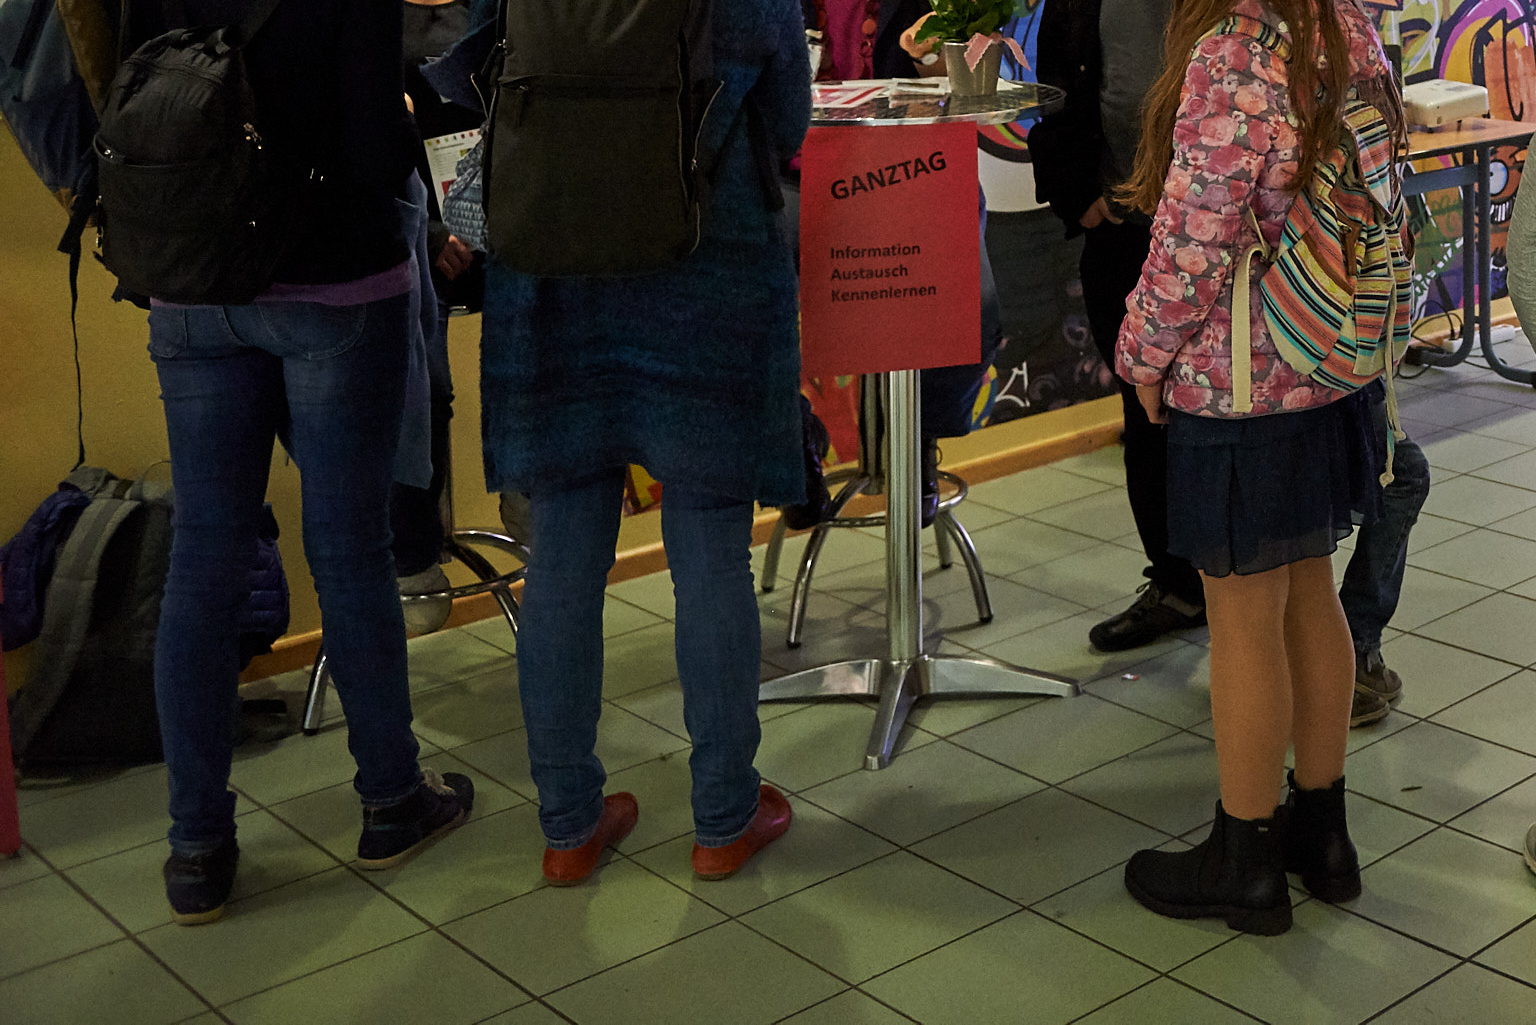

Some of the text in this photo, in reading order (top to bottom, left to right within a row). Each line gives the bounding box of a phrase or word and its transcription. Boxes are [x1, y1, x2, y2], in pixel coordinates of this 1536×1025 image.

[831, 151, 947, 200] GANZTAG
[831, 243, 921, 259] Information
[831, 264, 908, 281] Austausch
[831, 284, 937, 302] Kennenlernen
